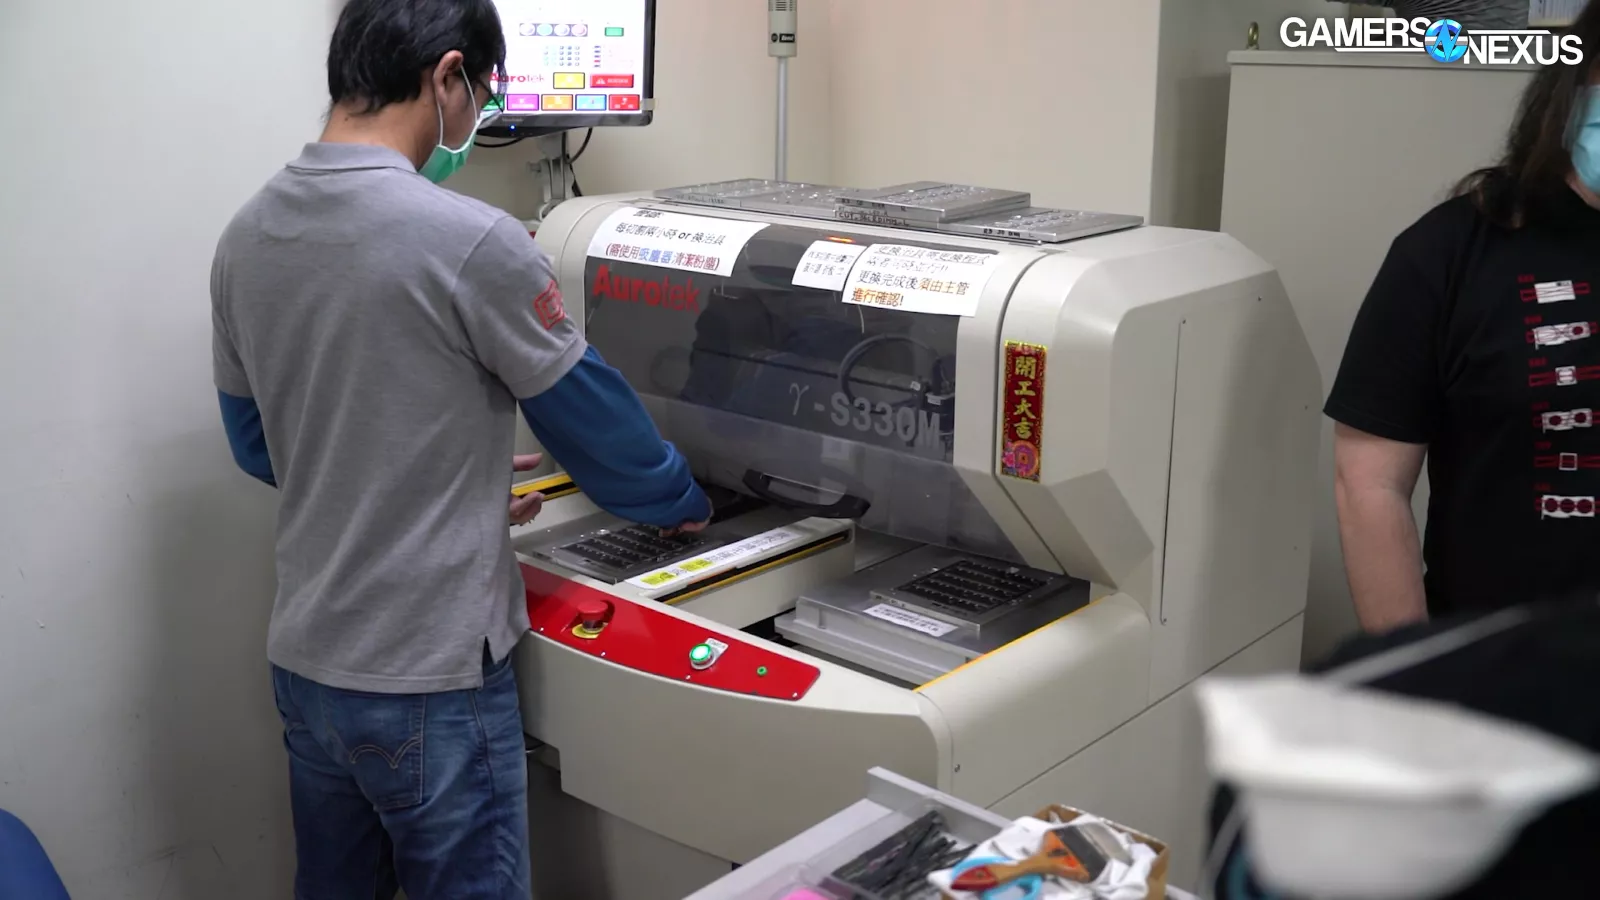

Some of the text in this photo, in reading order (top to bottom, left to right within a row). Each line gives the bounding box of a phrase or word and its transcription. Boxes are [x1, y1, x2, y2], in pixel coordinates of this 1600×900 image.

[678, 232, 690, 240] or
[592, 263, 702, 314] Aurotek
[851, 287, 904, 306] 進行確認!
[1014, 355, 1037, 440] 開工大吉
